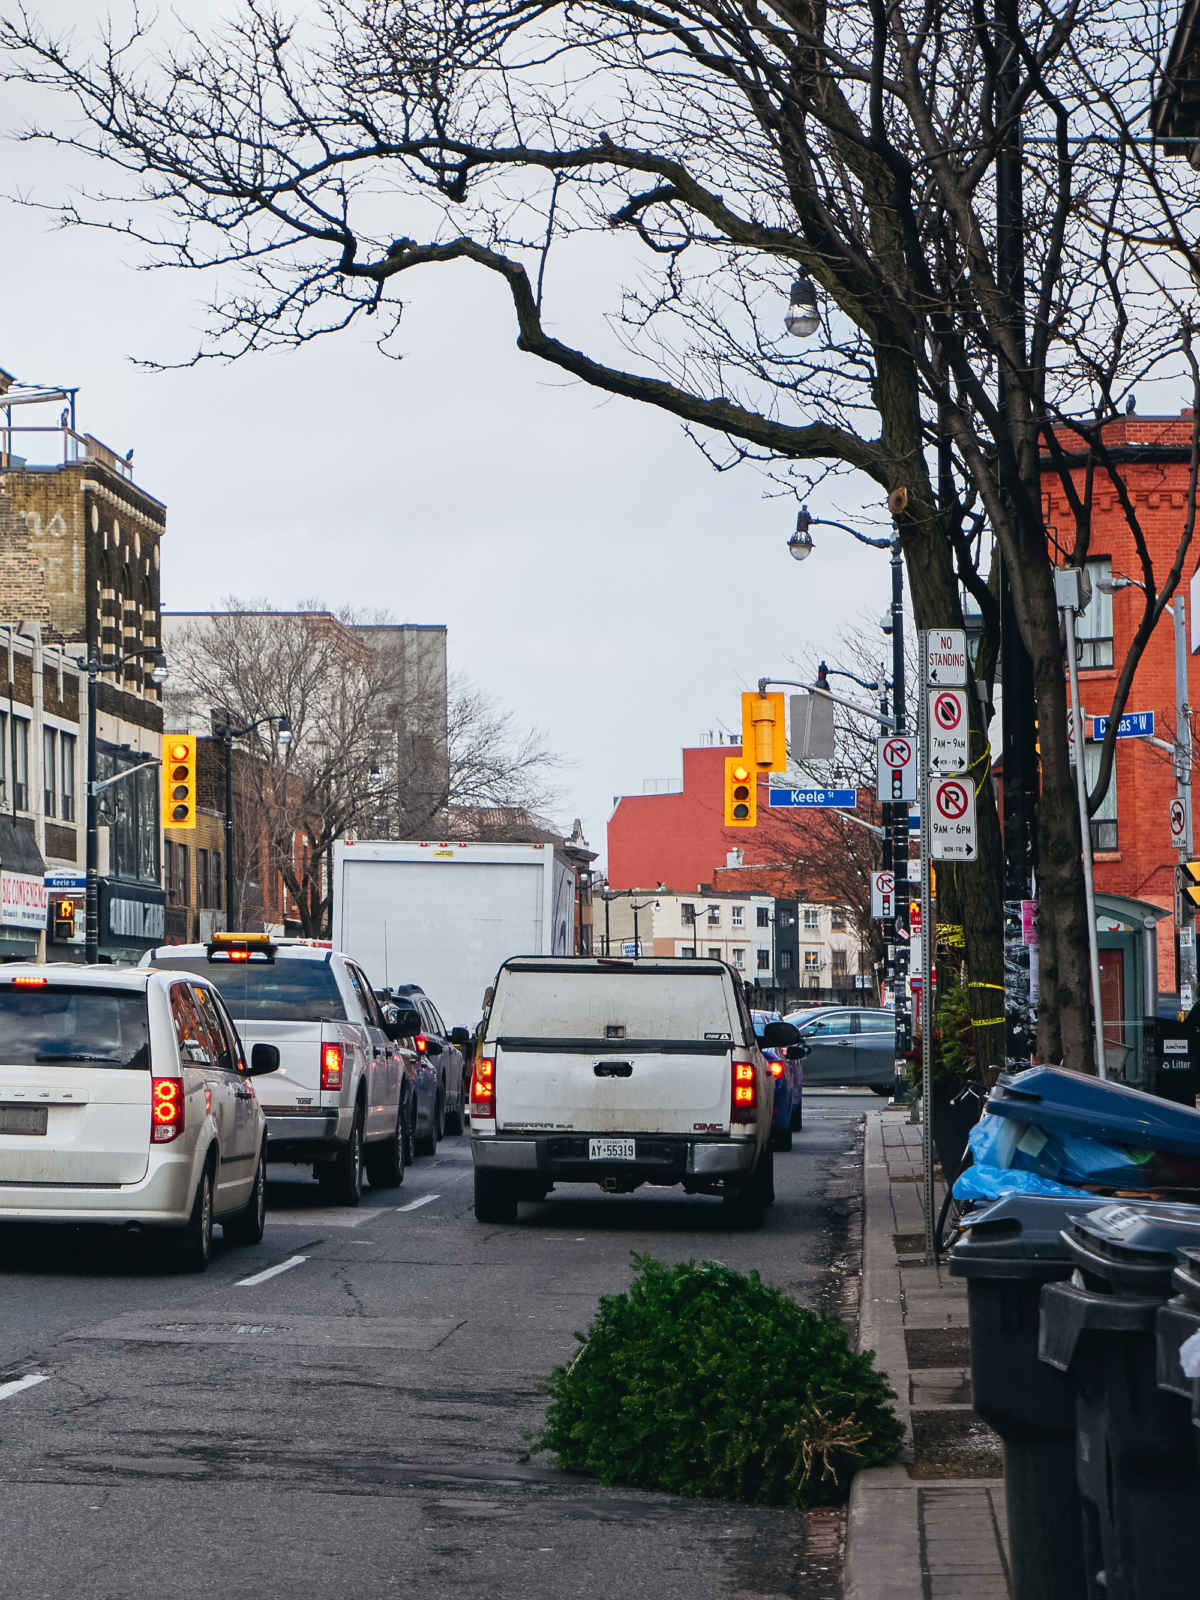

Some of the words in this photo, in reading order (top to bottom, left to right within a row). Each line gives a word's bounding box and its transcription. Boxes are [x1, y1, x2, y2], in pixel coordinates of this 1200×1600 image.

[940, 636, 953, 650] NO
[929, 652, 965, 667] STANDING
[1100, 718, 1132, 734] Das
[1139, 714, 1147, 731] W
[791, 790, 825, 803] Keele
[1172, 1060, 1190, 1069] Litter
[693, 1122, 724, 1131] GMC
[591, 1144, 602, 1157] AY
